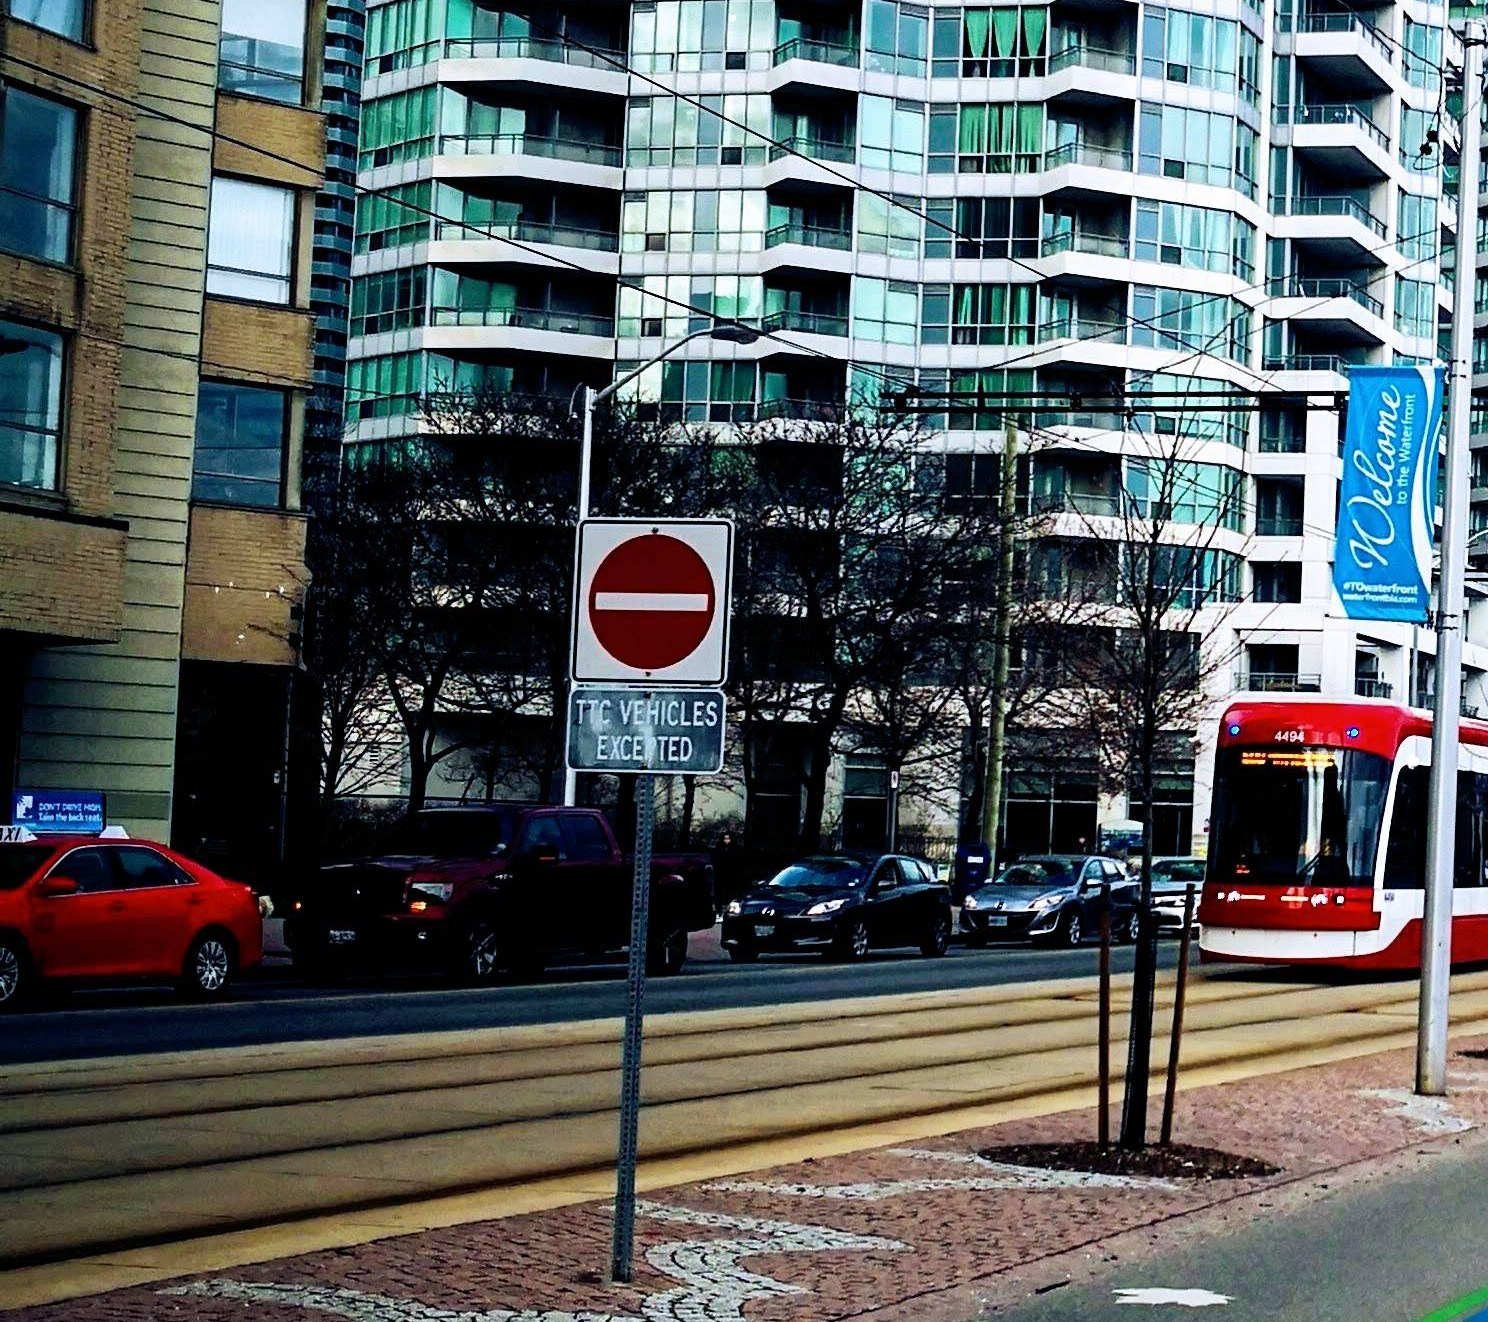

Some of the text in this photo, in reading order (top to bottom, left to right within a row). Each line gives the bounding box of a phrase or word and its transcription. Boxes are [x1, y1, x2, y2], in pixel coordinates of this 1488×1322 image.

[1347, 384, 1401, 569] Welcome
[1396, 394, 1416, 505] to the Waterfront
[576, 699, 718, 727] TTC VEHICLES
[1274, 730, 1305, 743] 4494
